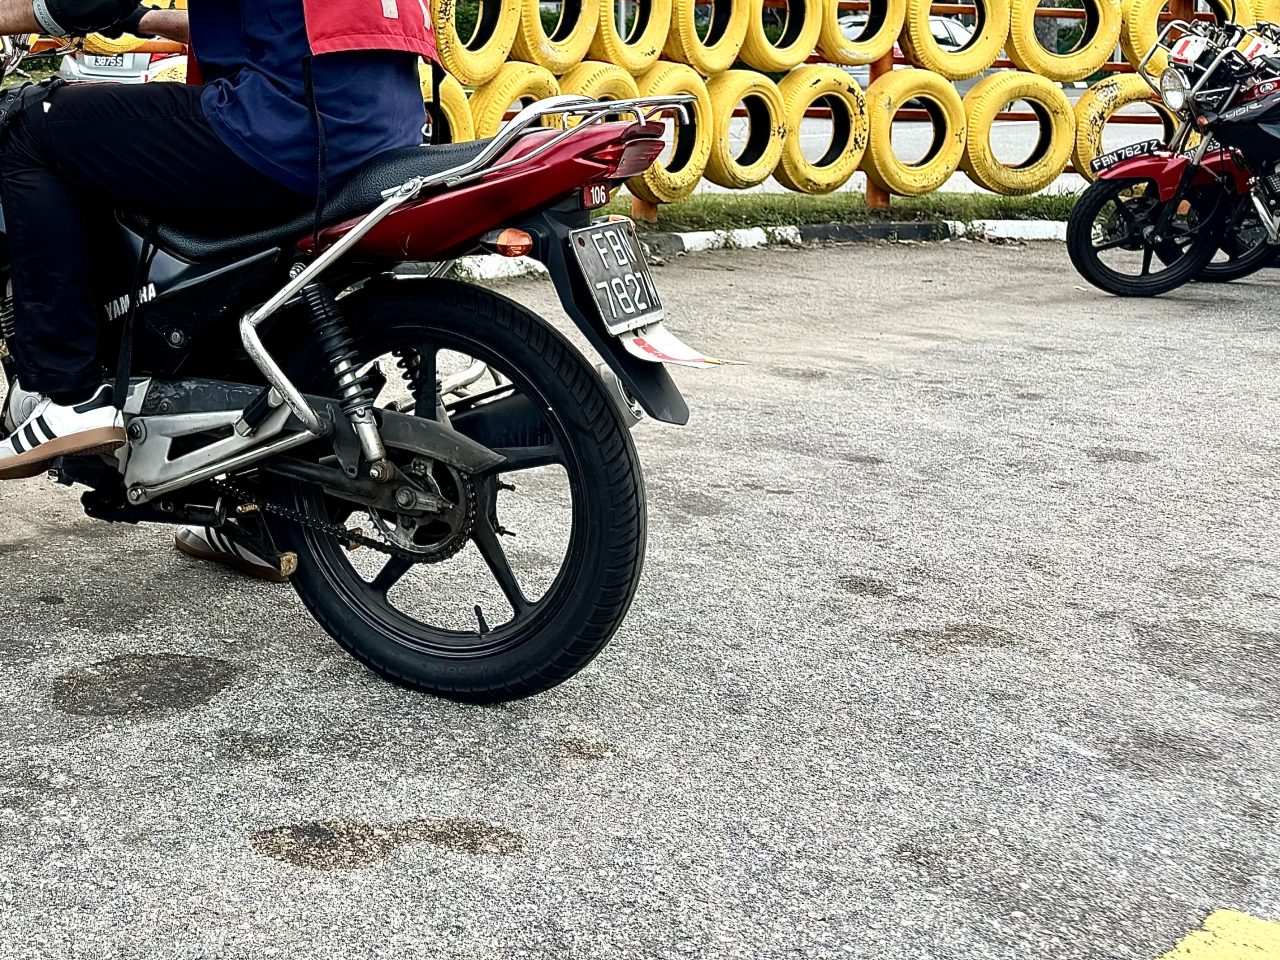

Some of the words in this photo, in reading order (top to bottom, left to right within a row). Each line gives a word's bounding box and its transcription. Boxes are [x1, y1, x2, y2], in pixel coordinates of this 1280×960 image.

[590, 185, 606, 205] 106
[591, 227, 637, 270] FBN
[104, 282, 157, 321] YAMHA
